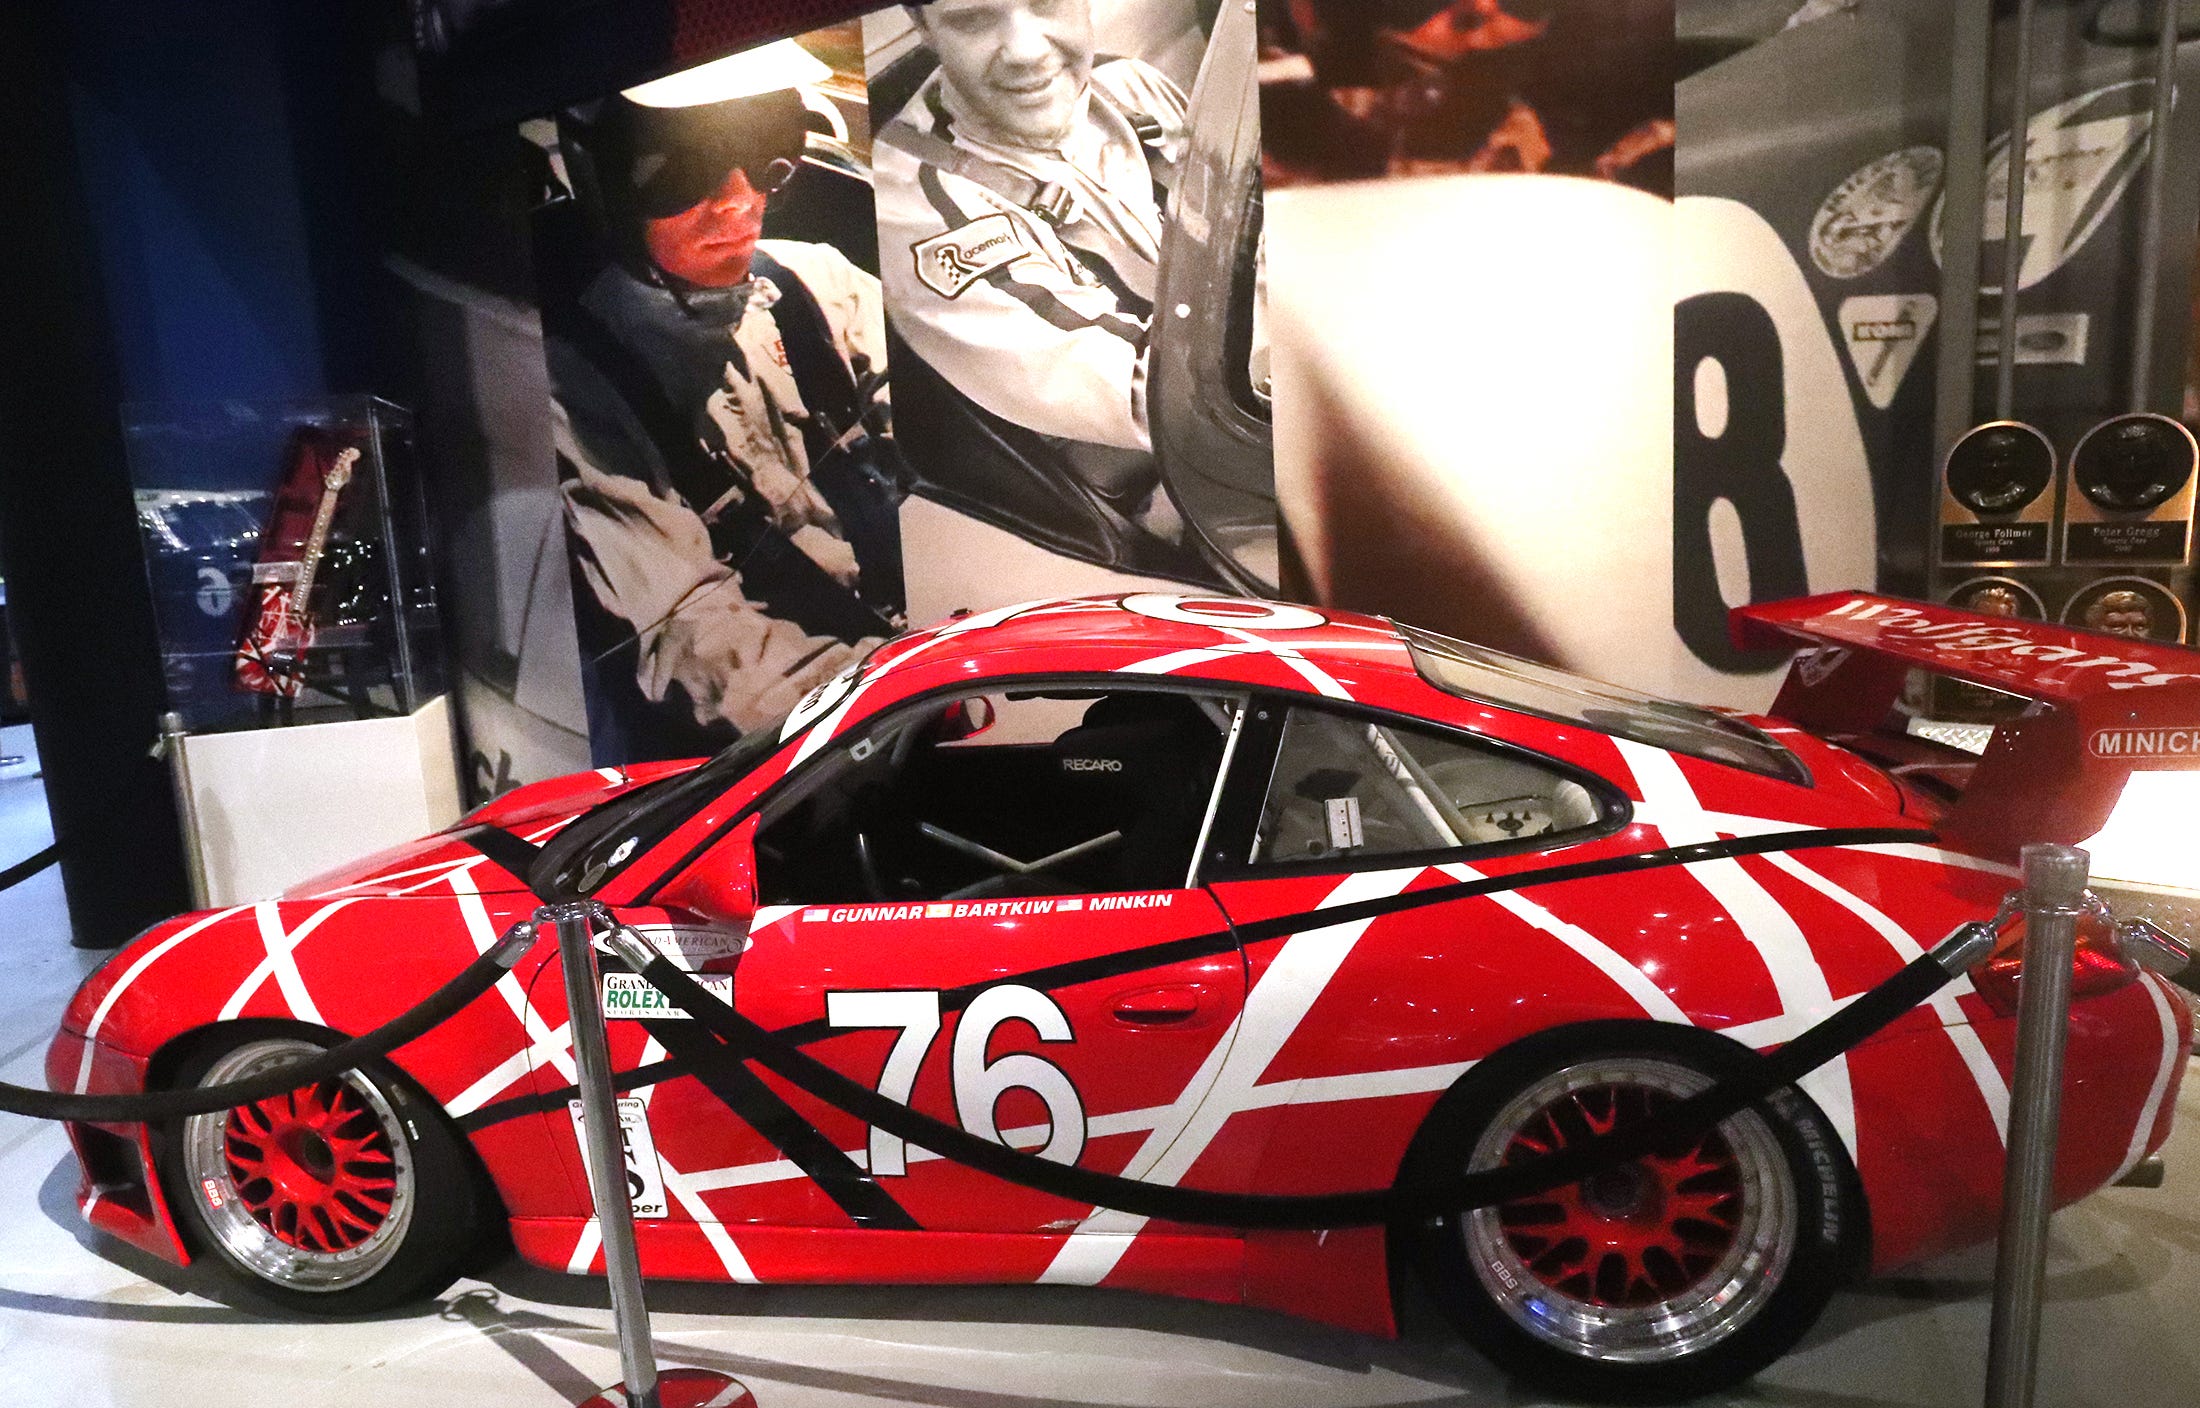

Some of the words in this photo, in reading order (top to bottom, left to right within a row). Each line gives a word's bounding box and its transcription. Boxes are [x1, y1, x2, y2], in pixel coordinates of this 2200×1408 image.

[1993, 527, 2033, 538] Follmer
[1062, 758, 1122, 772] RECARO
[831, 905, 923, 923] GUNNAR
[953, 900, 1054, 919] BARTKIW
[1088, 894, 1173, 912] MINKIN
[606, 990, 665, 1009] ROLEX
[826, 983, 1087, 1177] 76
[204, 1180, 223, 1207] BBS
[1491, 1260, 1518, 1289] BBS
